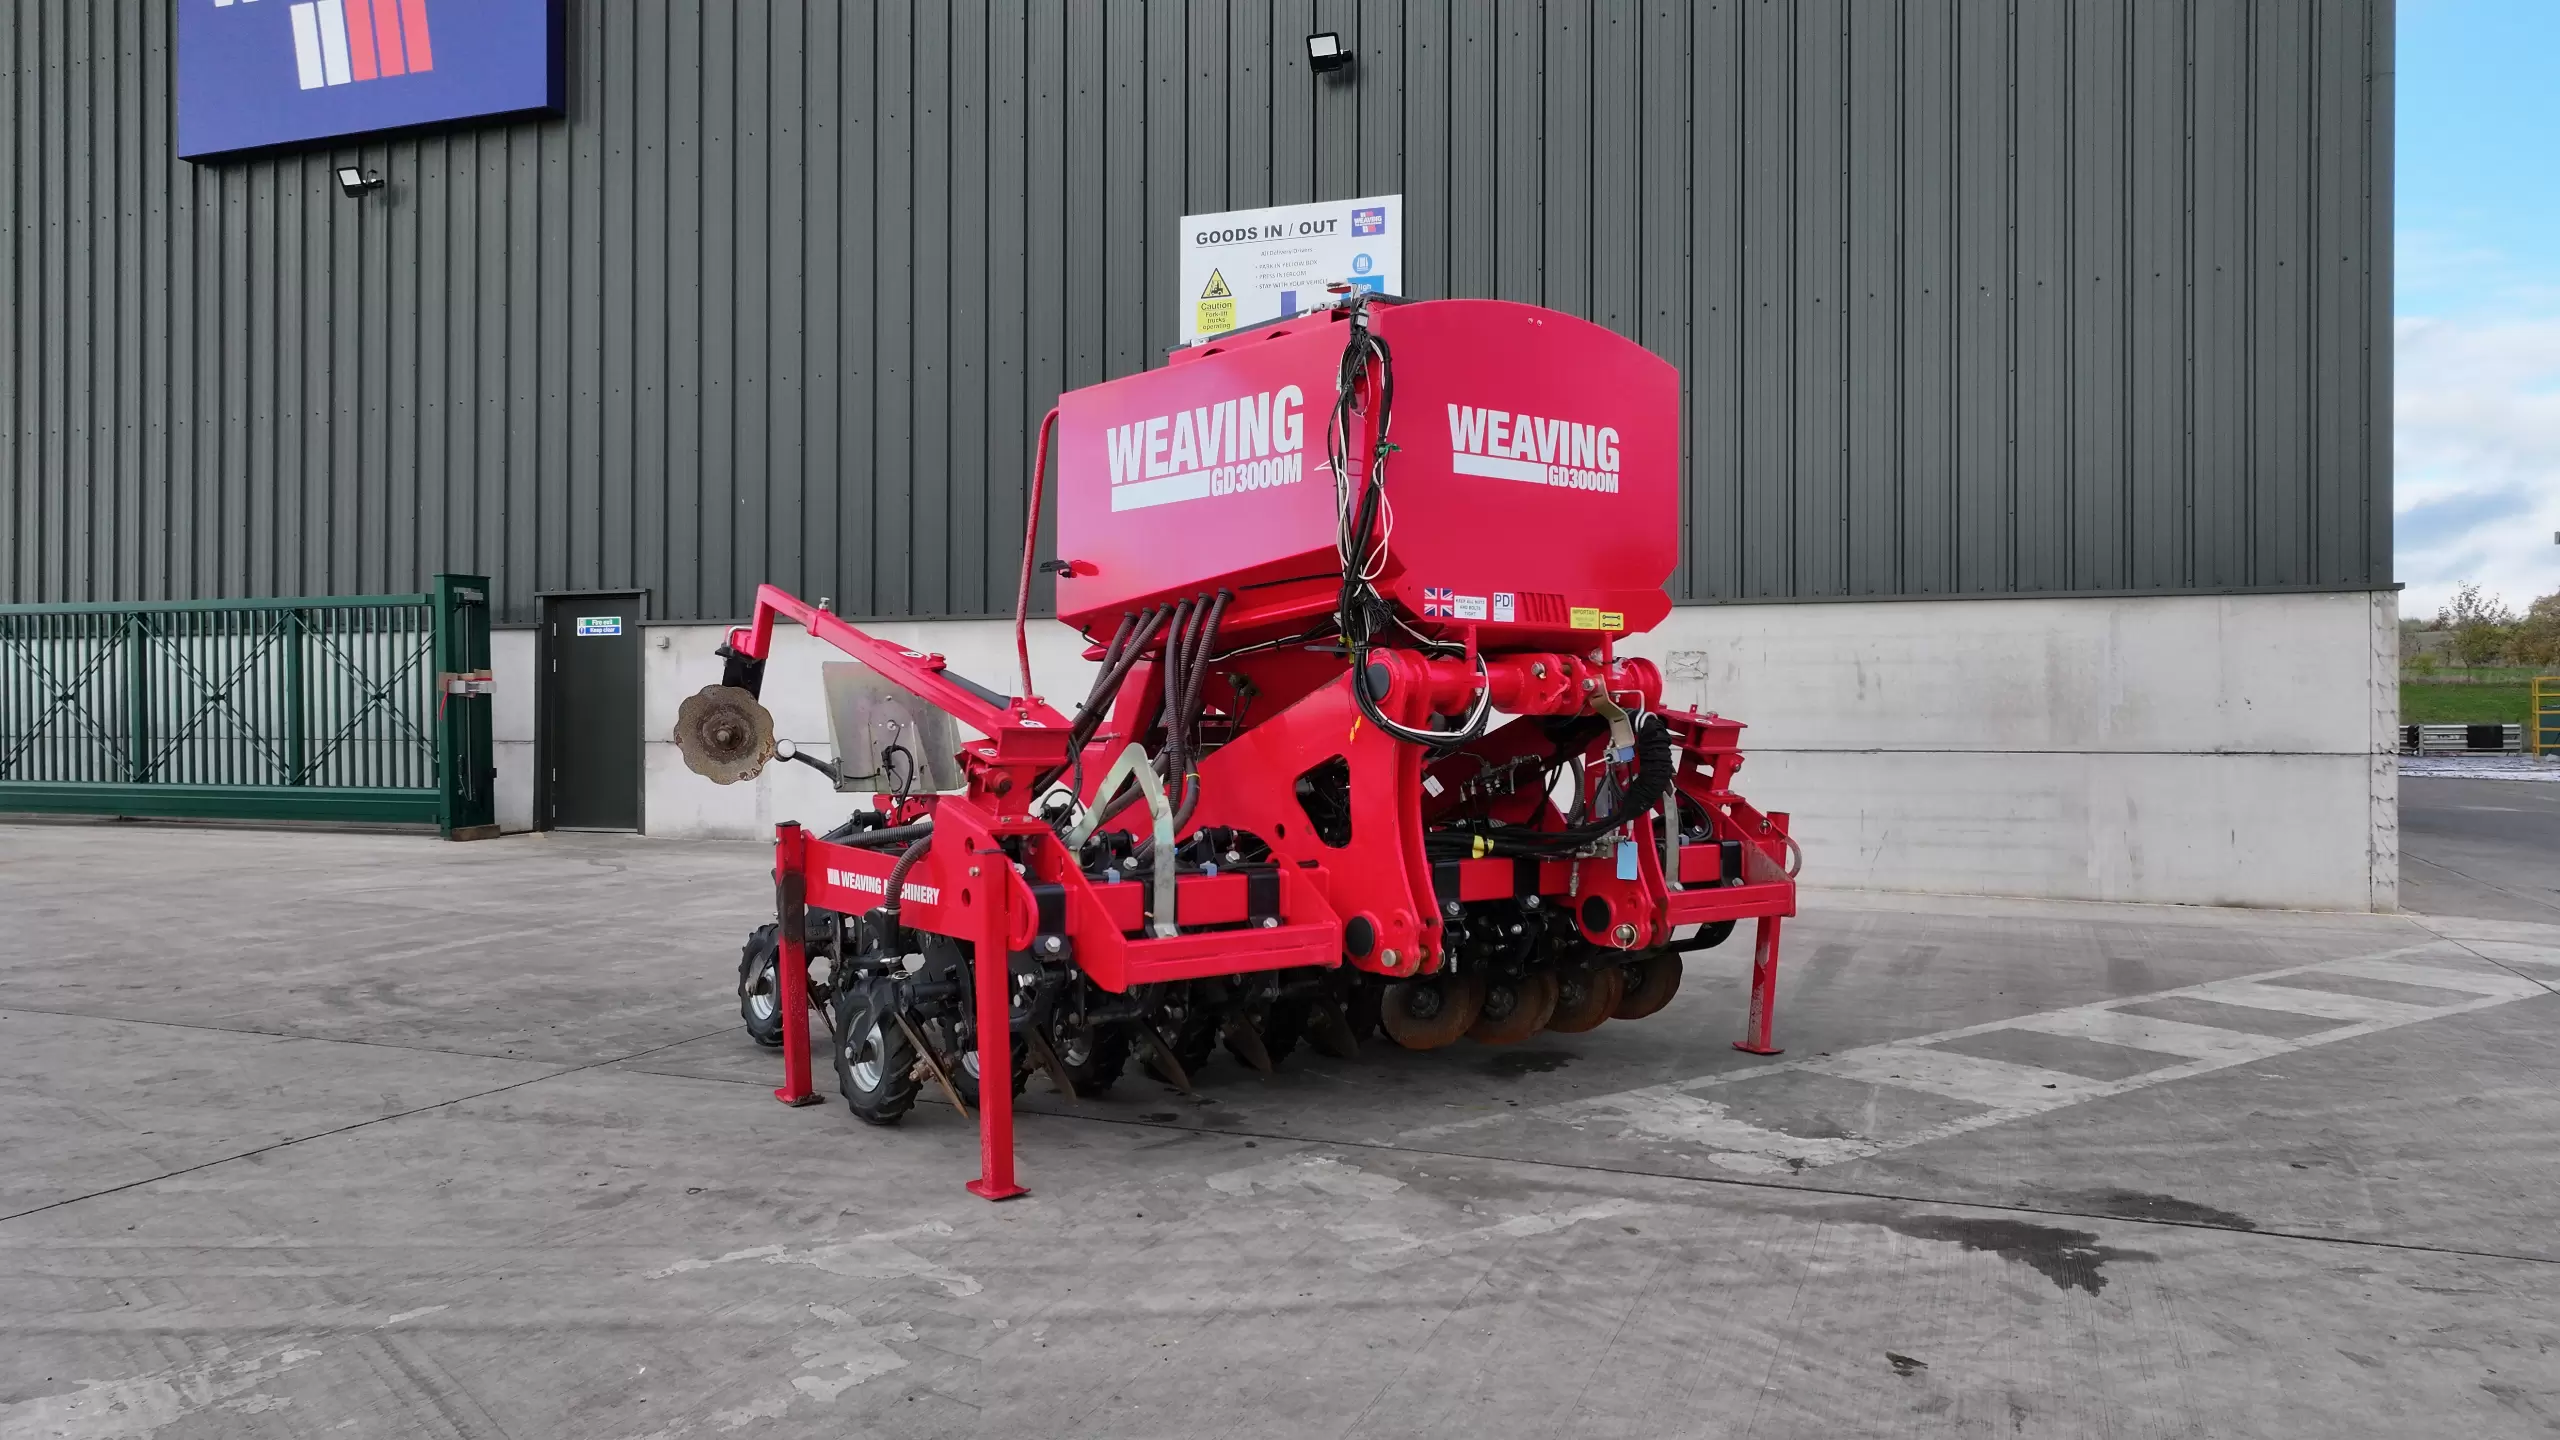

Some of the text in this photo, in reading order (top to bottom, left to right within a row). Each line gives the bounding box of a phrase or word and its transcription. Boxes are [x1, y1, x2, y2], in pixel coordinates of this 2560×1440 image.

[1196, 219, 1338, 245] GOODS IN / OUT
[1282, 260, 1305, 268] YELLOW
[1276, 270, 1307, 278] INTERCOM
[1306, 278, 1328, 286] VEHICL
[1201, 301, 1232, 311] Caution
[1202, 323, 1231, 331] operating
[1106, 384, 1304, 485] WEAVING
[1447, 403, 1620, 472] WEAVING
[1211, 453, 1302, 497] GD3000M
[1548, 465, 1619, 493] GD3000M
[1494, 594, 1513, 607] PDI
[840, 870, 940, 905] WEAVING MCHINERY
